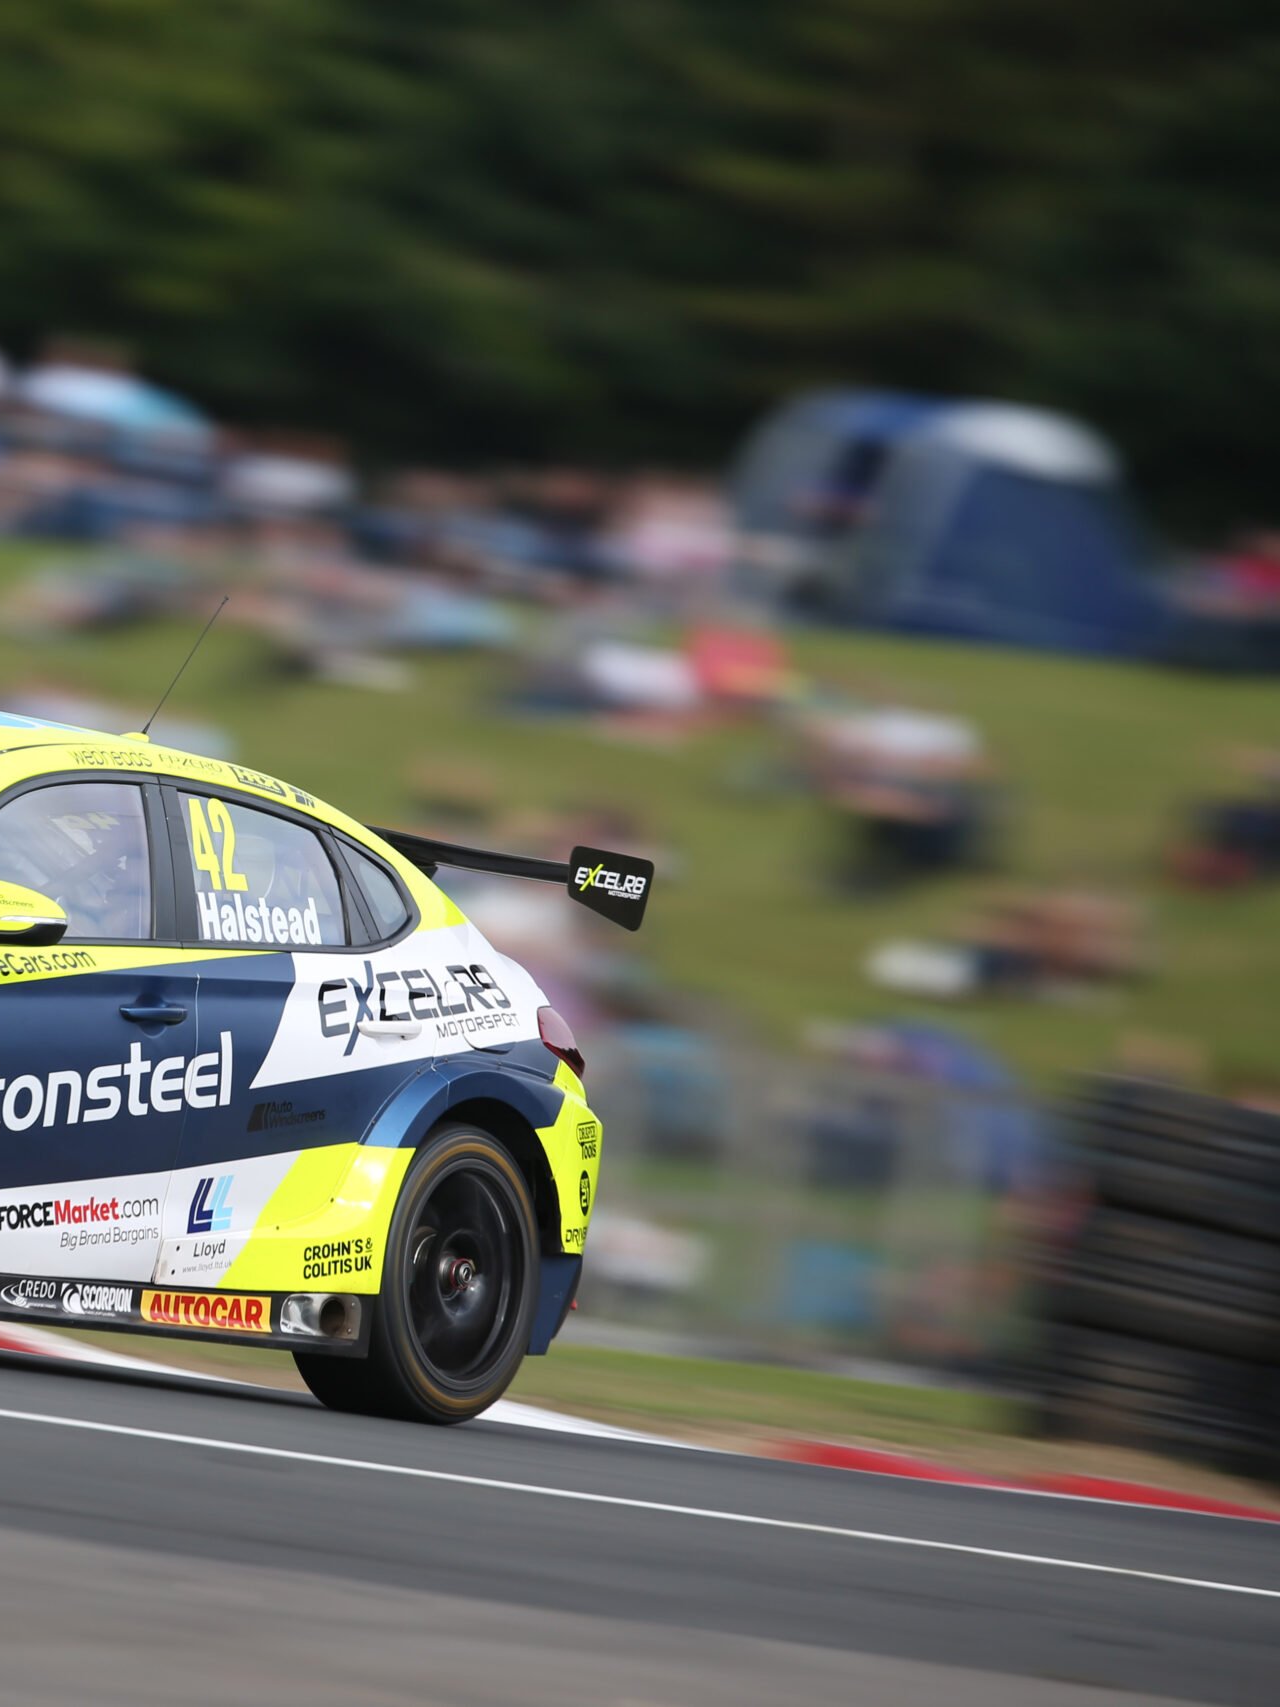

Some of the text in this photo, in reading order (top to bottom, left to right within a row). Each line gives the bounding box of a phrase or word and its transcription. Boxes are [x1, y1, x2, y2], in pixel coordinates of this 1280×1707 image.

[188, 798, 248, 891] 42
[574, 863, 647, 895] EXCELR8
[197, 892, 322, 945] Halstead
[318, 960, 511, 1056] EXCELR8
[436, 1012, 521, 1039] MOTORSPORT
[60, 1223, 160, 1250] Big Brand Bargains
[193, 1239, 227, 1260] Lloyd
[303, 1237, 373, 1262] CROHN'S &
[303, 1254, 373, 1280] COLITIS UK
[18, 1279, 57, 1299] CREDO
[82, 1285, 134, 1313] SCORPION
[149, 1294, 264, 1330] AUTOCAR
